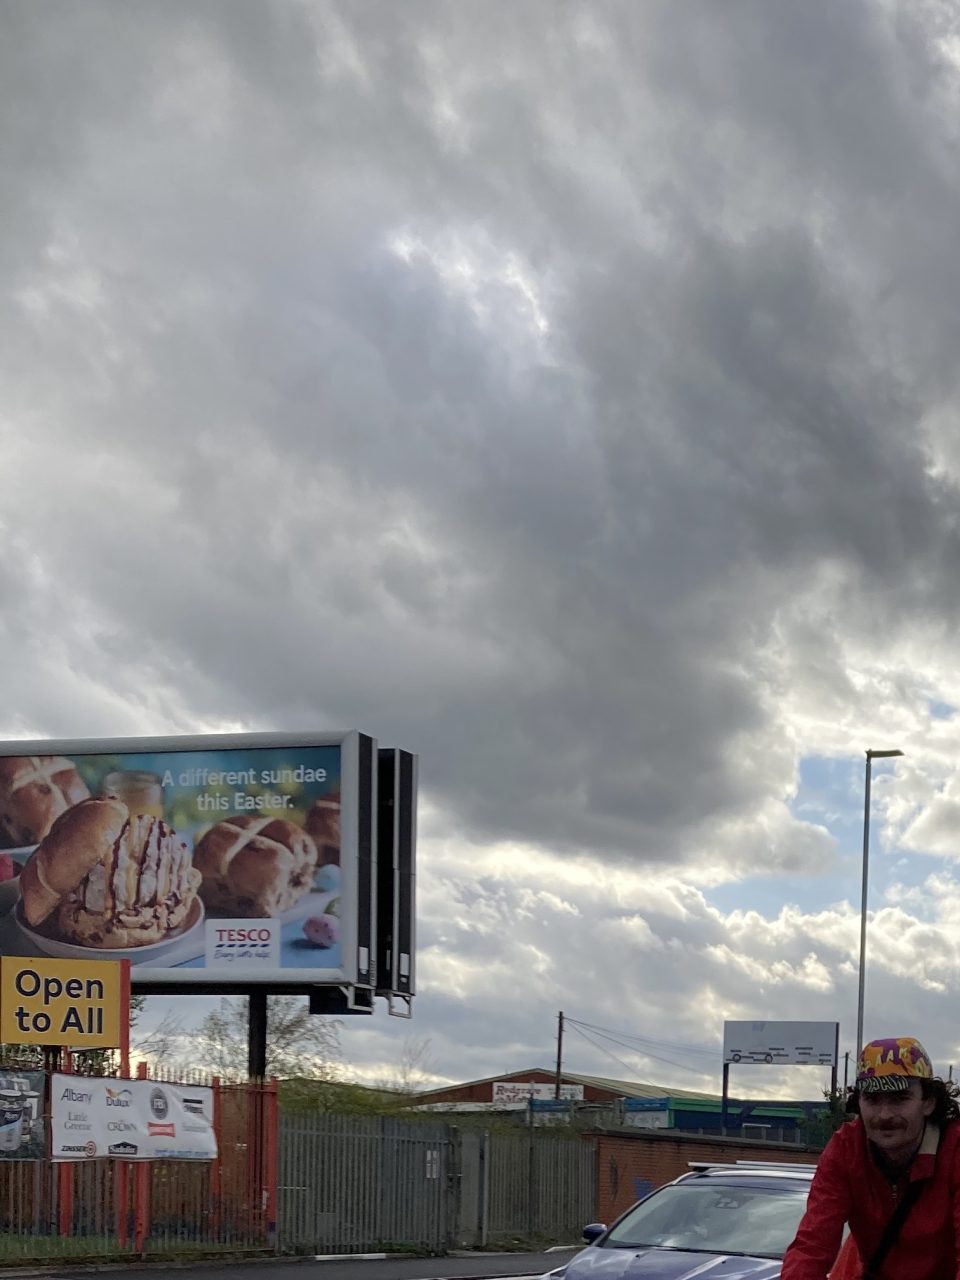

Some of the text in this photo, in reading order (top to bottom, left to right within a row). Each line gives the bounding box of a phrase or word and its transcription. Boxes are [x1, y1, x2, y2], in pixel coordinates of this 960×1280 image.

[161, 764, 327, 787] A different sundae
[196, 791, 294, 811] this Easter.
[215, 928, 271, 942] TESCO
[15, 969, 104, 1005] Open
[15, 1006, 103, 1034] to All
[61, 1088, 93, 1105] Albany
